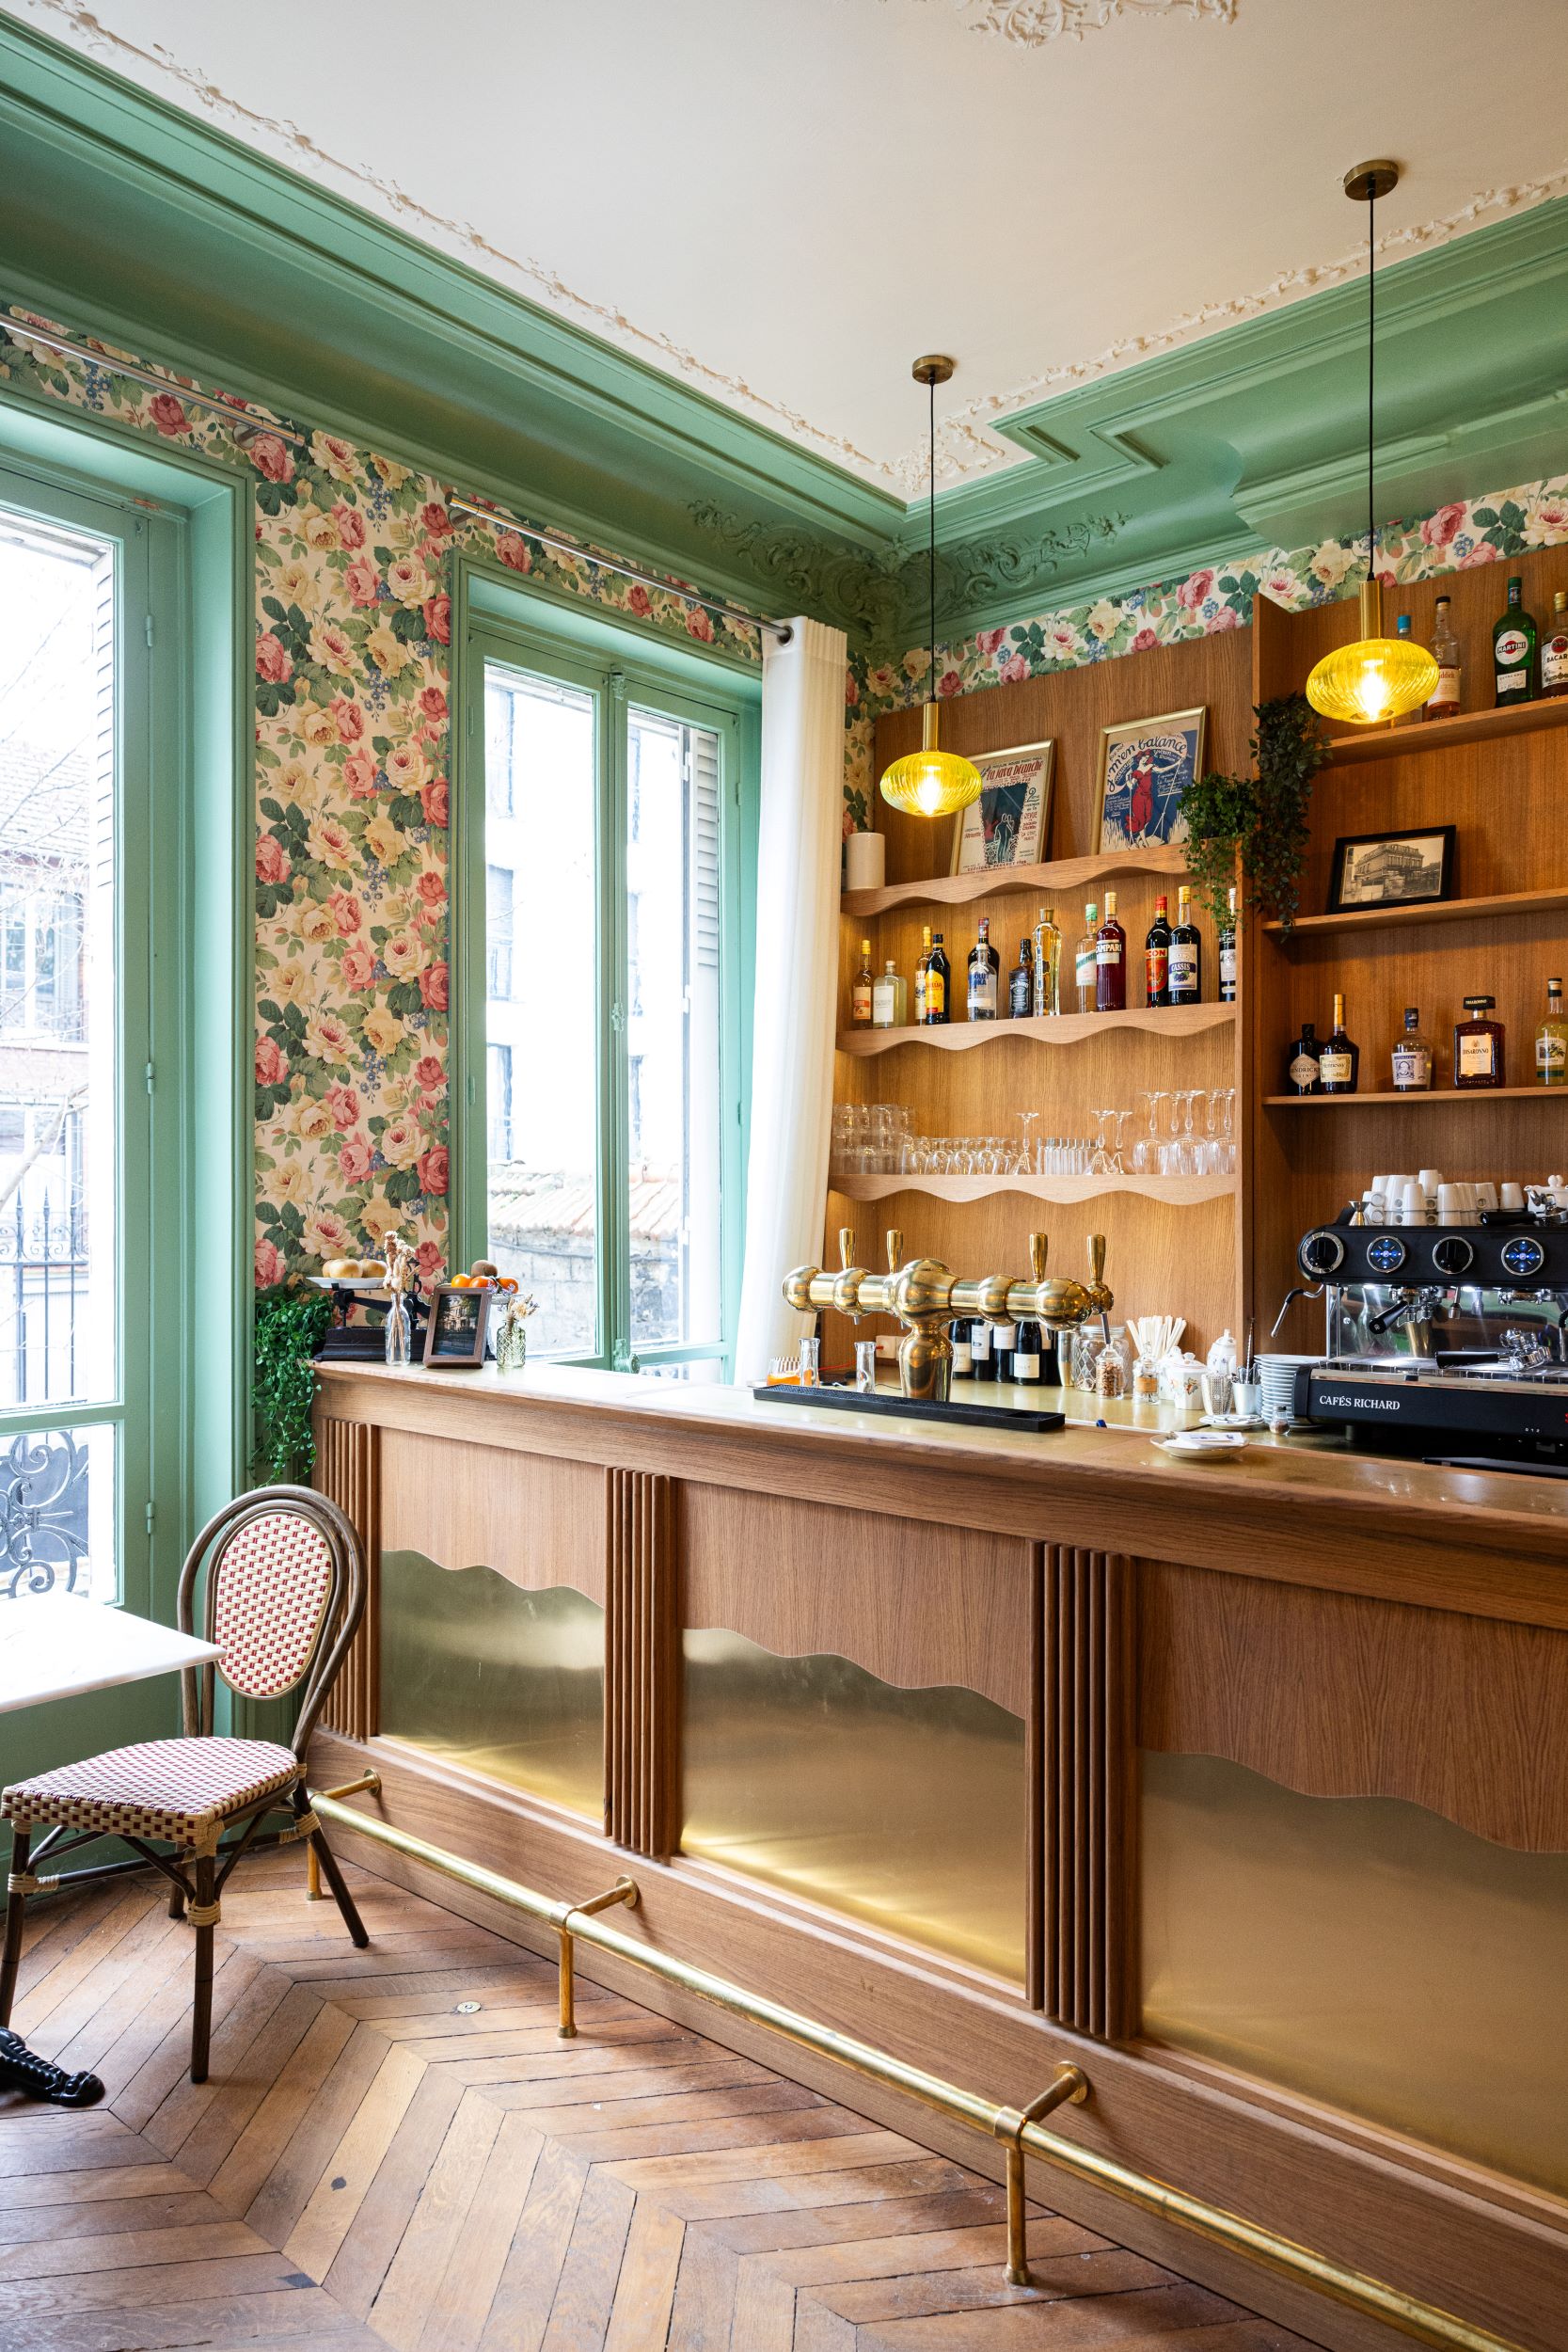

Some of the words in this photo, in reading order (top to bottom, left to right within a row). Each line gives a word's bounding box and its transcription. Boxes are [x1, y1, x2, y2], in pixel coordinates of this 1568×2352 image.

[1497, 642, 1526, 654] MARTINI
[1138, 736, 1187, 755] balance
[1171, 962, 1191, 971] CASSIS
[1319, 1395, 1352, 1406] CAFÉS
[1354, 1398, 1401, 1410] RICHARD
